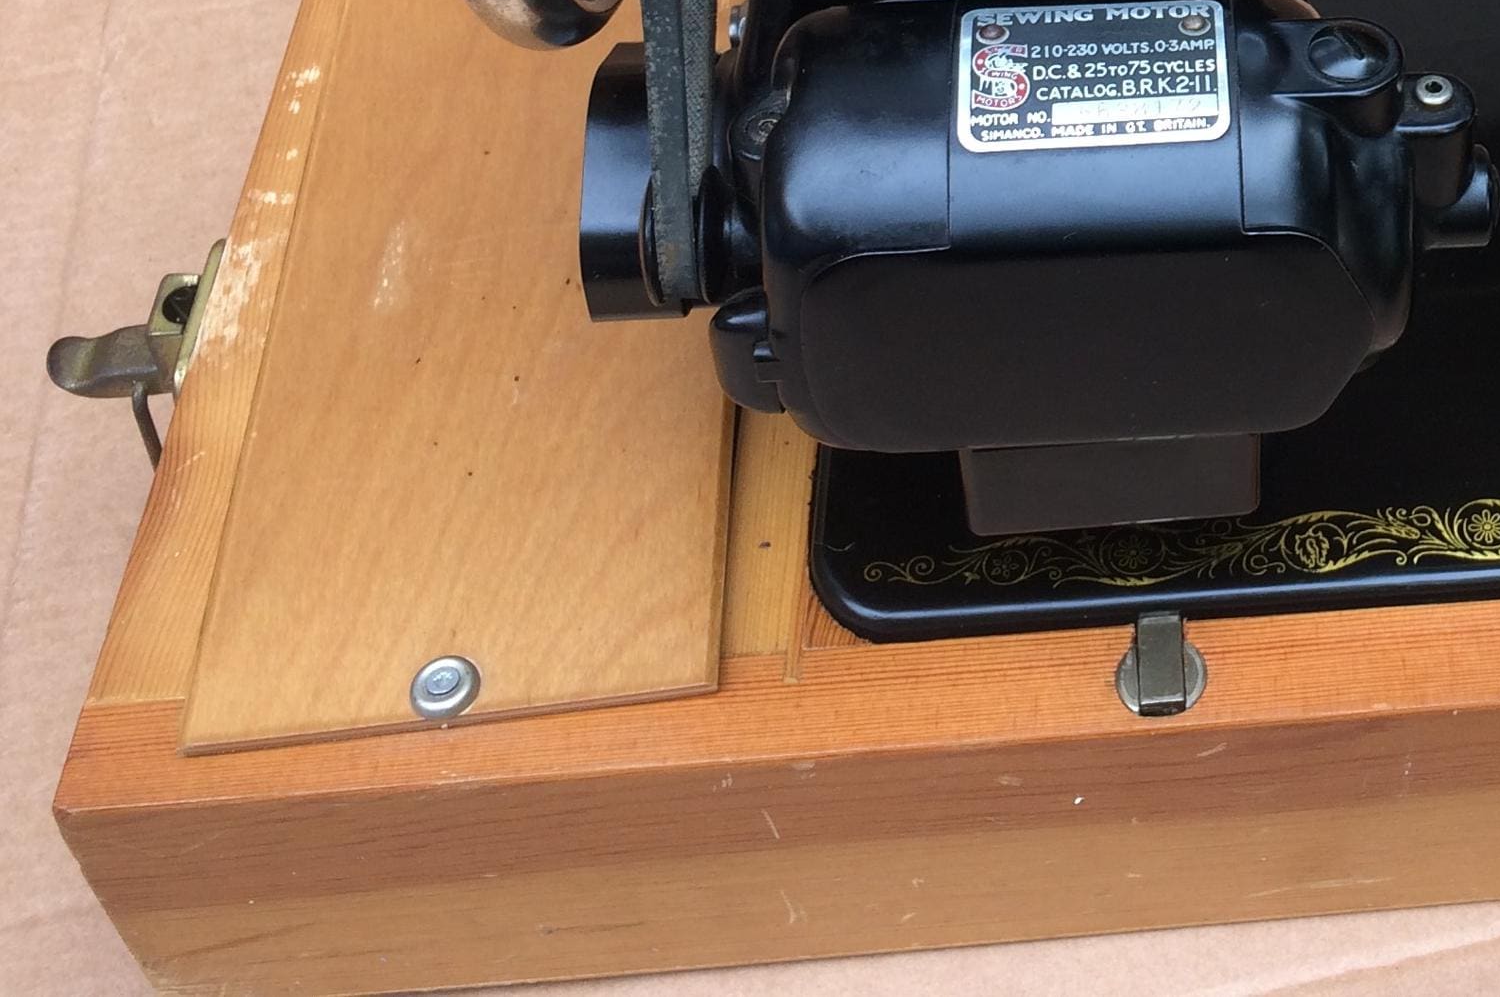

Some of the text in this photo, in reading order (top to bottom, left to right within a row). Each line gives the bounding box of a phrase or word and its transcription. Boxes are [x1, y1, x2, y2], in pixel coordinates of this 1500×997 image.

[977, 4, 1211, 26] SEWING MOTOR
[1031, 43, 1098, 59] 210-230
[970, 111, 1018, 127] MOTOR
[980, 126, 1045, 142] SIMANCO.
[1052, 123, 1095, 137] MADE
[1101, 122, 1117, 134] IN
[1153, 118, 1211, 132] BRITAIN.
